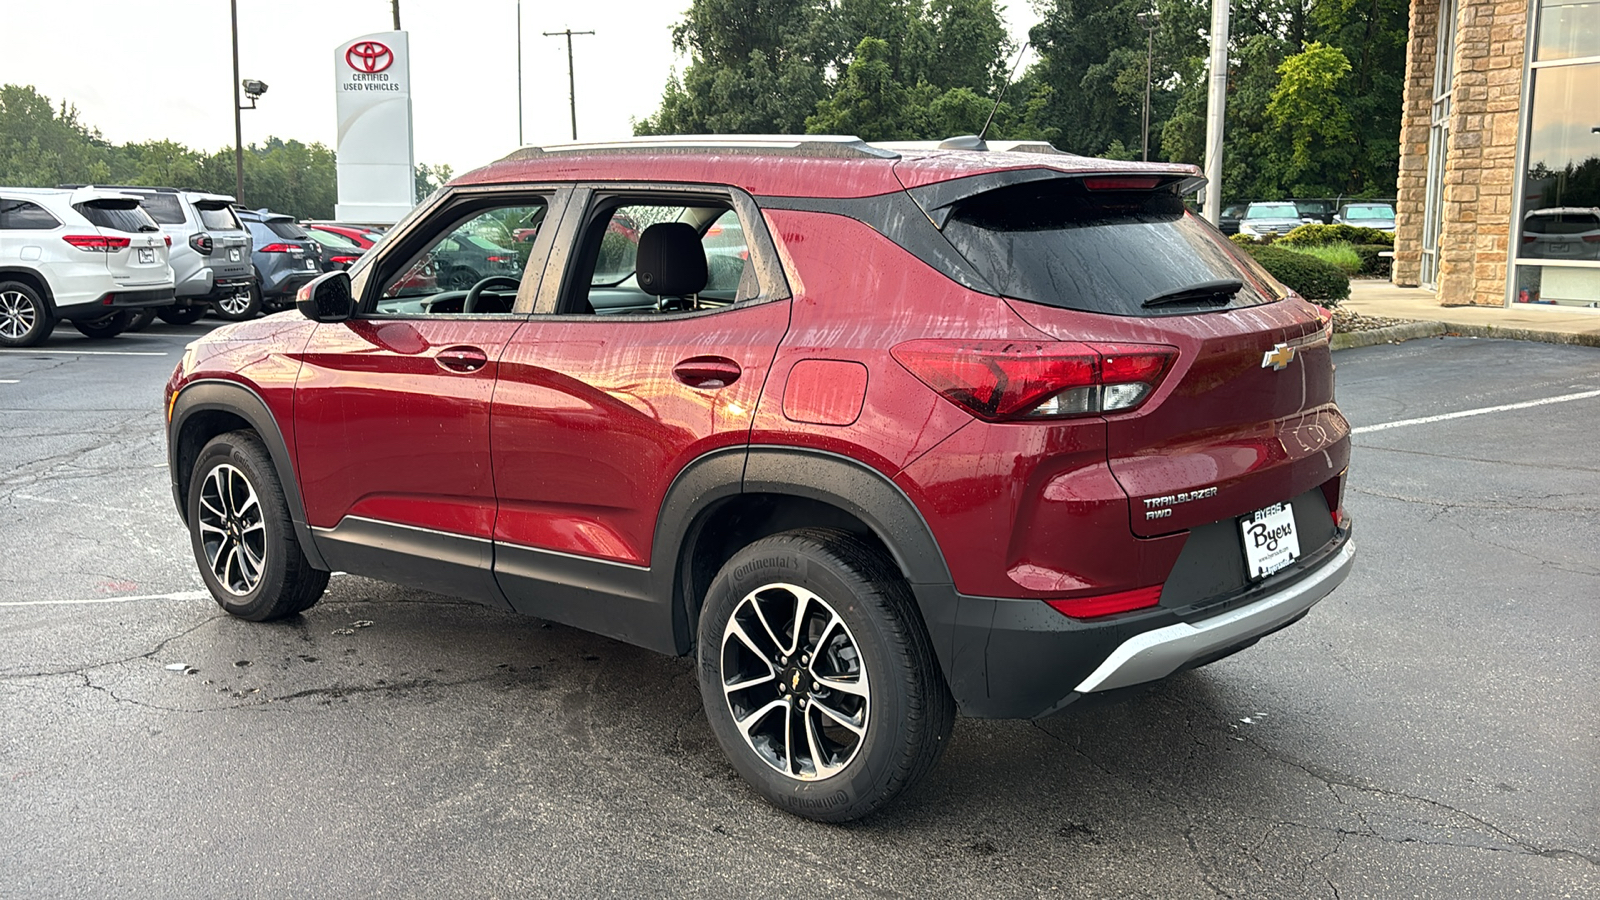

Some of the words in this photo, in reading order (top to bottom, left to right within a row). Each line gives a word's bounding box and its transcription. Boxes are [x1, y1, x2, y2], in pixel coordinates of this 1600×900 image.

[343, 83, 363, 91] USED
[364, 83, 400, 91] VEHICLES
[352, 73, 389, 82] CERTIFIED
[1143, 486, 1218, 509] TRAILBLAZER
[1145, 508, 1173, 520] AWD
[1254, 502, 1282, 522] BYERS
[1246, 522, 1292, 552] Byers
[733, 555, 790, 581] Continental
